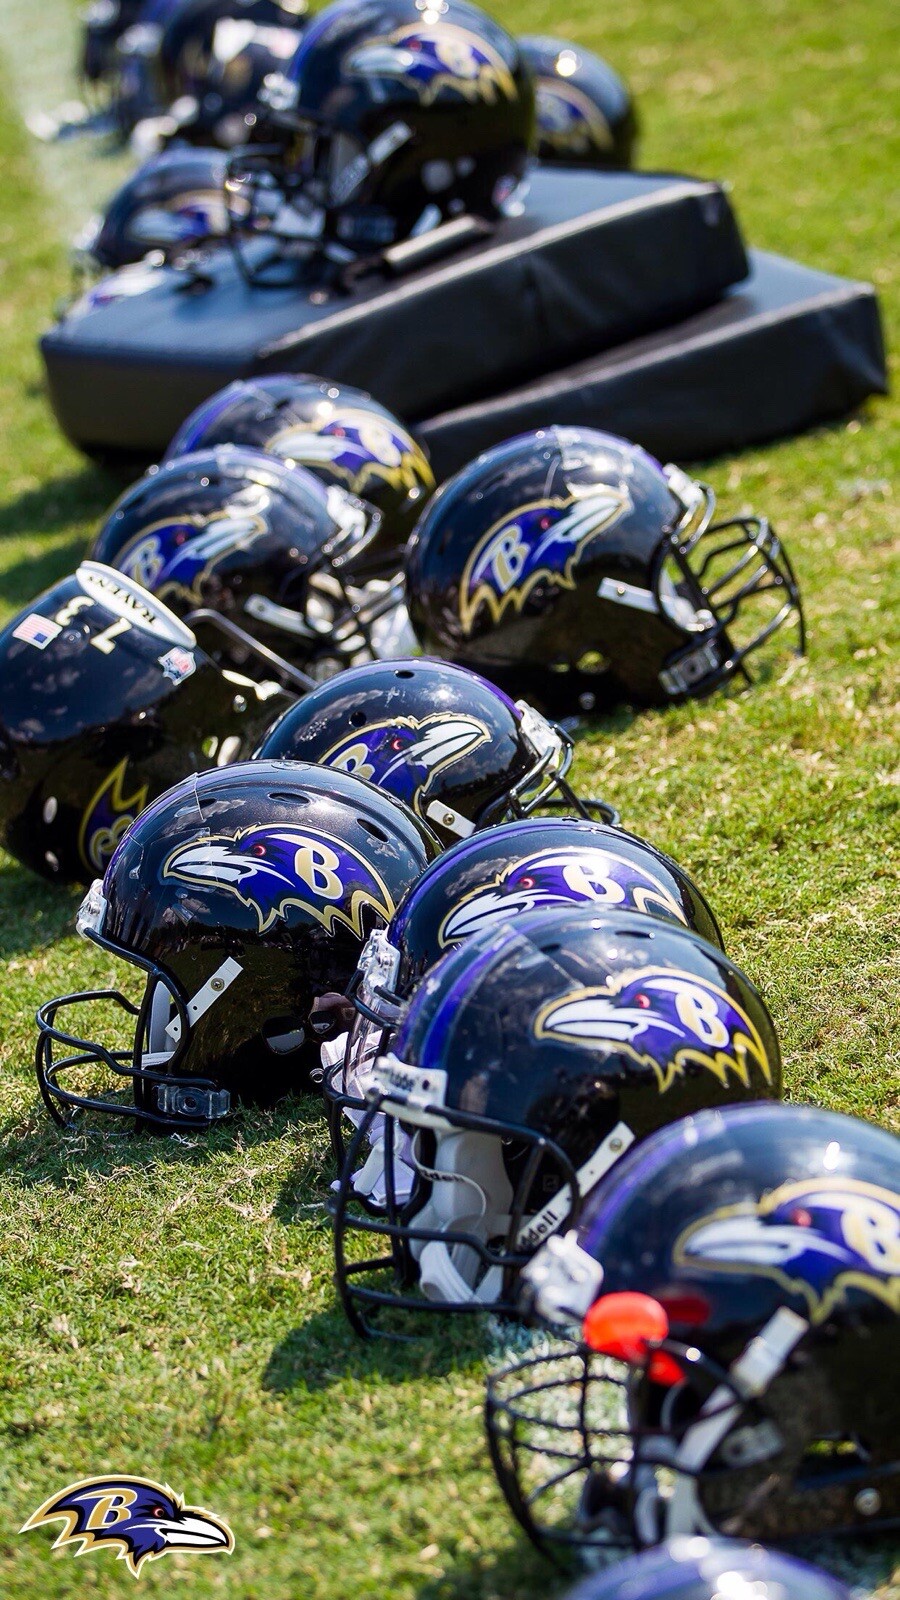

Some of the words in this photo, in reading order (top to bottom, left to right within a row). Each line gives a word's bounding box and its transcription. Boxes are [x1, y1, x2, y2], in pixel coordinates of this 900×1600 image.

[474, 524, 531, 593] B
[55, 595, 132, 655] 73
[87, 575, 157, 626] RAVENS
[275, 834, 344, 900] B
[542, 856, 625, 904] B
[660, 979, 729, 1048] B
